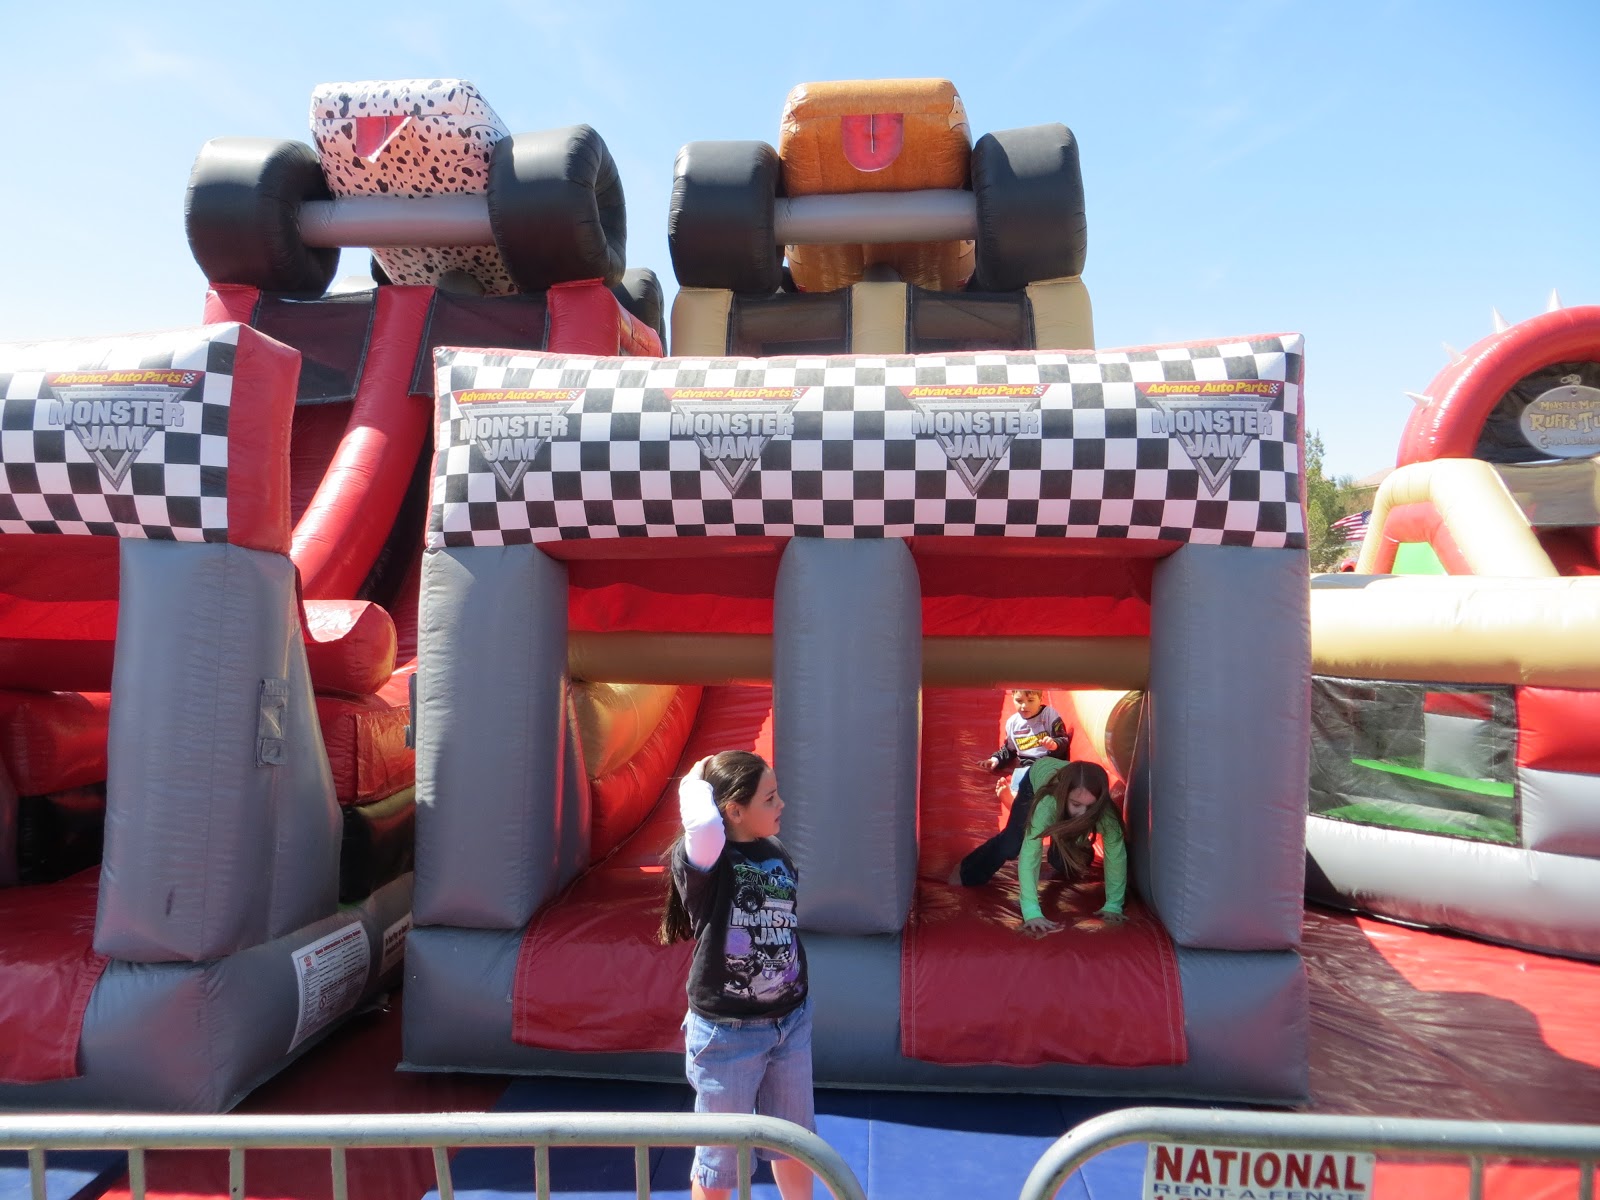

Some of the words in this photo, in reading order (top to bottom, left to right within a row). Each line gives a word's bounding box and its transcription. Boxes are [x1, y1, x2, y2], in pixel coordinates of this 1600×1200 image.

[53, 374, 108, 385] Advance
[109, 372, 142, 383] Auto
[142, 371, 182, 384] Parts
[1146, 383, 1201, 394] Advance
[1201, 382, 1235, 393] Auto
[1235, 382, 1269, 394] Parts
[459, 391, 506, 403] Advance
[503, 390, 534, 401] Auto
[534, 390, 568, 400] Parts
[672, 389, 723, 399] Advance
[723, 388, 757, 398] Auto
[757, 388, 791, 398] Parts
[909, 387, 962, 397] Advance
[962, 386, 996, 396] Auto
[996, 385, 1033, 395] Parts
[49, 400, 185, 427] MONSTER
[1540, 401, 1577, 411] MONSTER
[459, 415, 569, 441] MONSTER
[671, 413, 795, 437] MONSTER
[911, 411, 1040, 436] MONSTER
[1151, 410, 1273, 436] MONSTER
[1529, 413, 1569, 432] RUFF
[83, 425, 146, 452] JAM
[482, 438, 539, 463] JAM
[702, 436, 764, 461] JAM
[944, 434, 1004, 460] JAM
[1185, 434, 1245, 459] JAM
[754, 927, 792, 946] JAM
[1155, 1145, 1366, 1192] NATIONAL
[1153, 1183, 1365, 1200] RENT-A-FENCE
